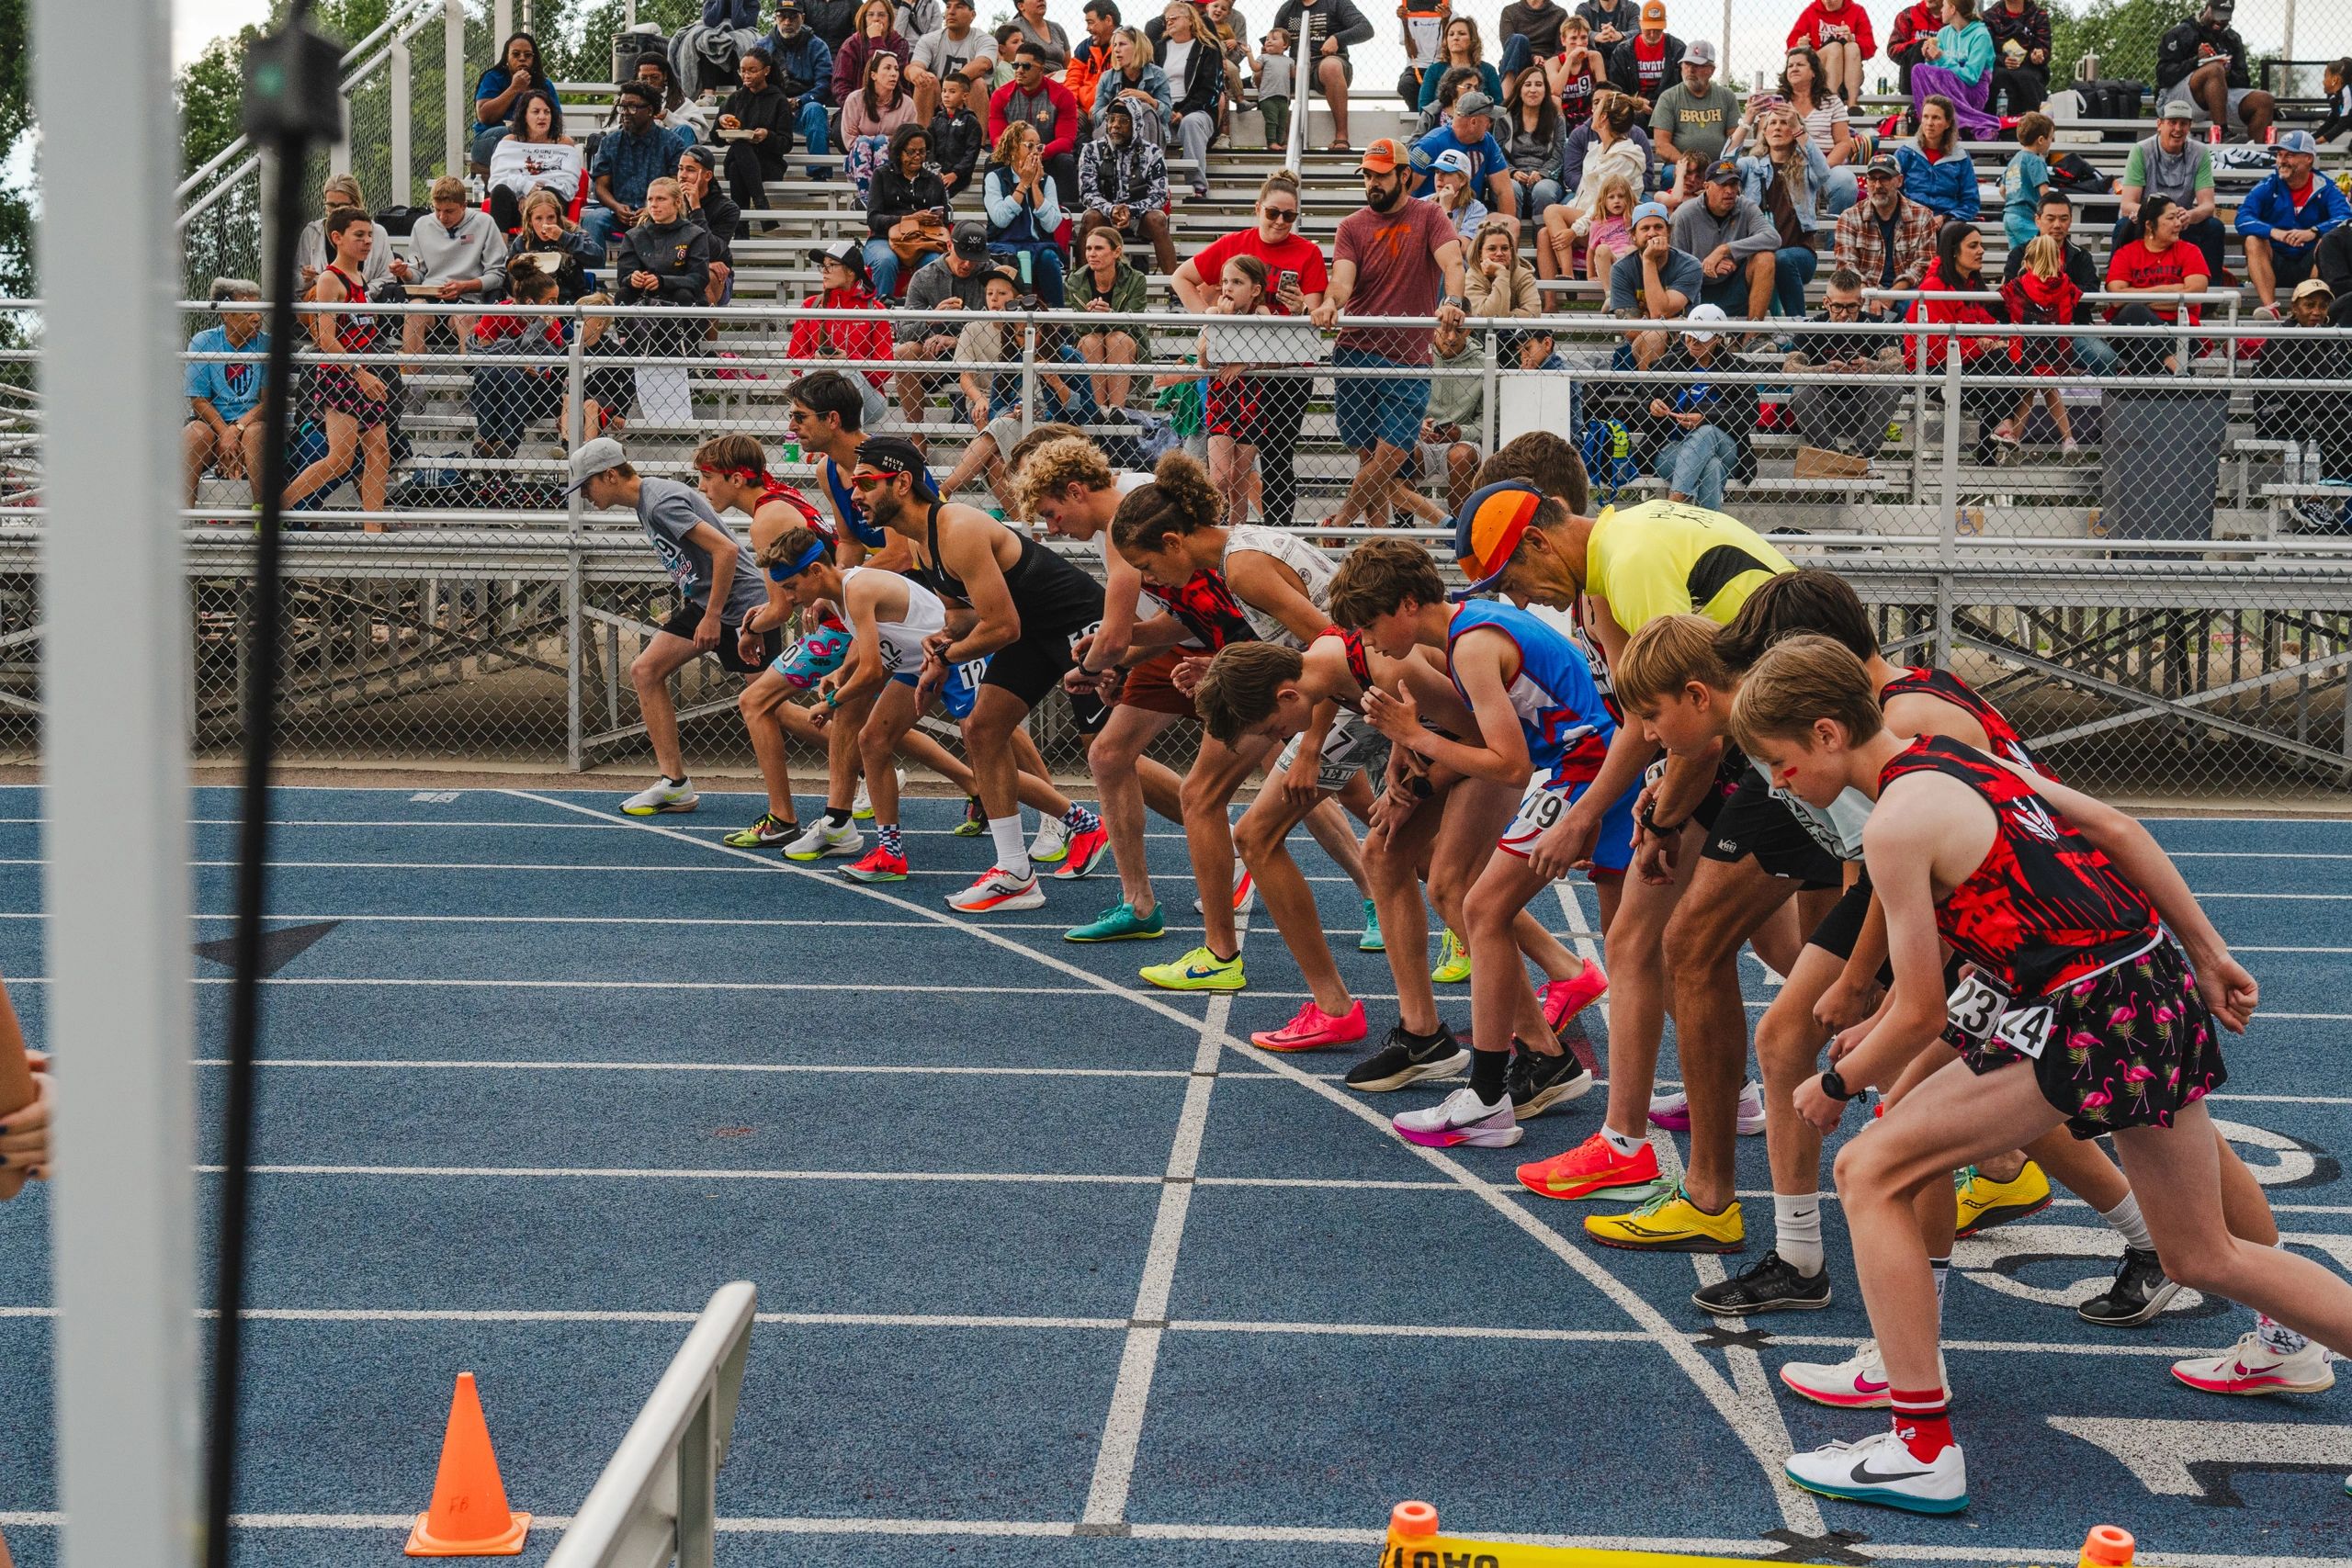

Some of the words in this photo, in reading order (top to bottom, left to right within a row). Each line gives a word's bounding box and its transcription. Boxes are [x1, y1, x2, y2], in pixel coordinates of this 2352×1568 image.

[1580, 77, 1589, 91] 9
[1679, 108, 1723, 123] BRUH
[882, 460, 903, 472] MILE
[655, 537, 677, 558] 9
[962, 660, 986, 688] 12
[1524, 790, 1562, 829] 19
[1948, 979, 1998, 1033] 23
